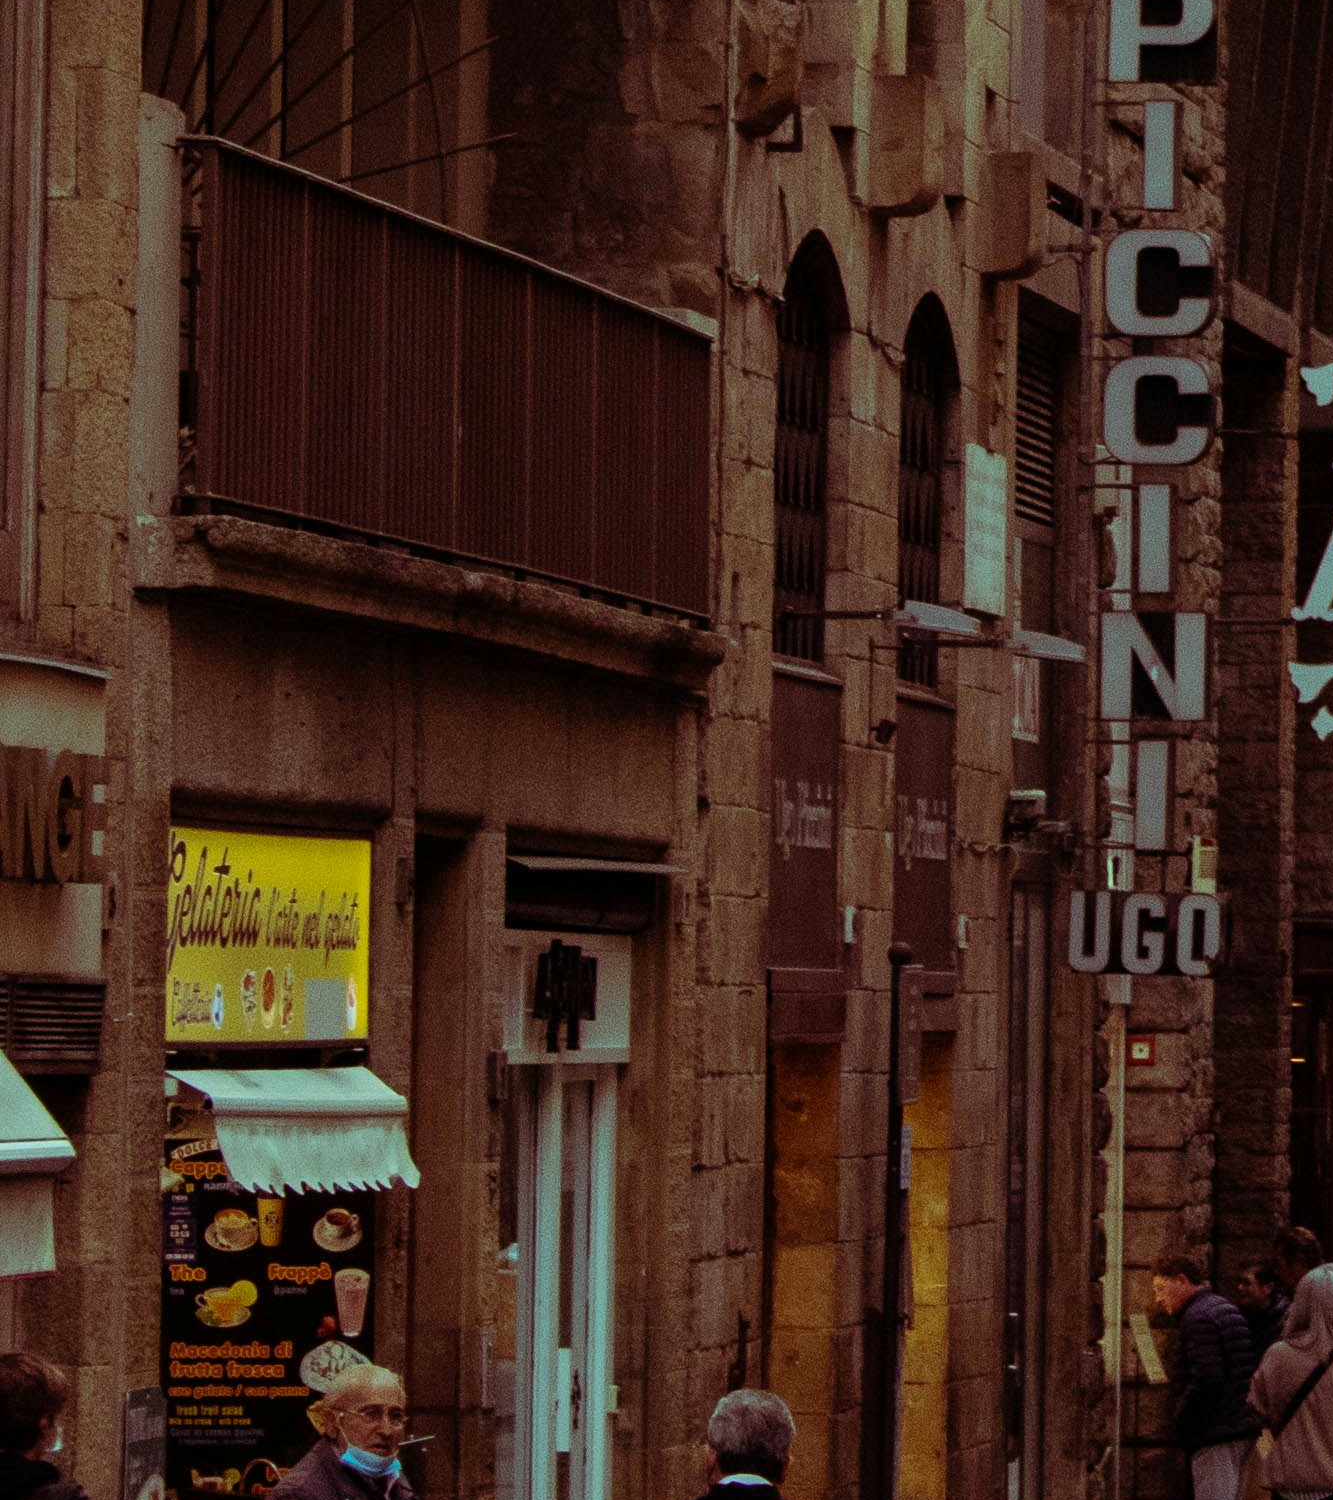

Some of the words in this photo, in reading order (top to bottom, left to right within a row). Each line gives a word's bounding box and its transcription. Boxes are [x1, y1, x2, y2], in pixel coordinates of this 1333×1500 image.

[167, 831, 262, 975] Gelateria
[1068, 889, 1222, 976] UGO
[168, 1263, 207, 1282] The
[267, 1261, 333, 1285] Frappè
[169, 1341, 270, 1359] Macedonia
[274, 1341, 293, 1359] di
[169, 1361, 223, 1379] frutta
[226, 1361, 285, 1379] fresca
